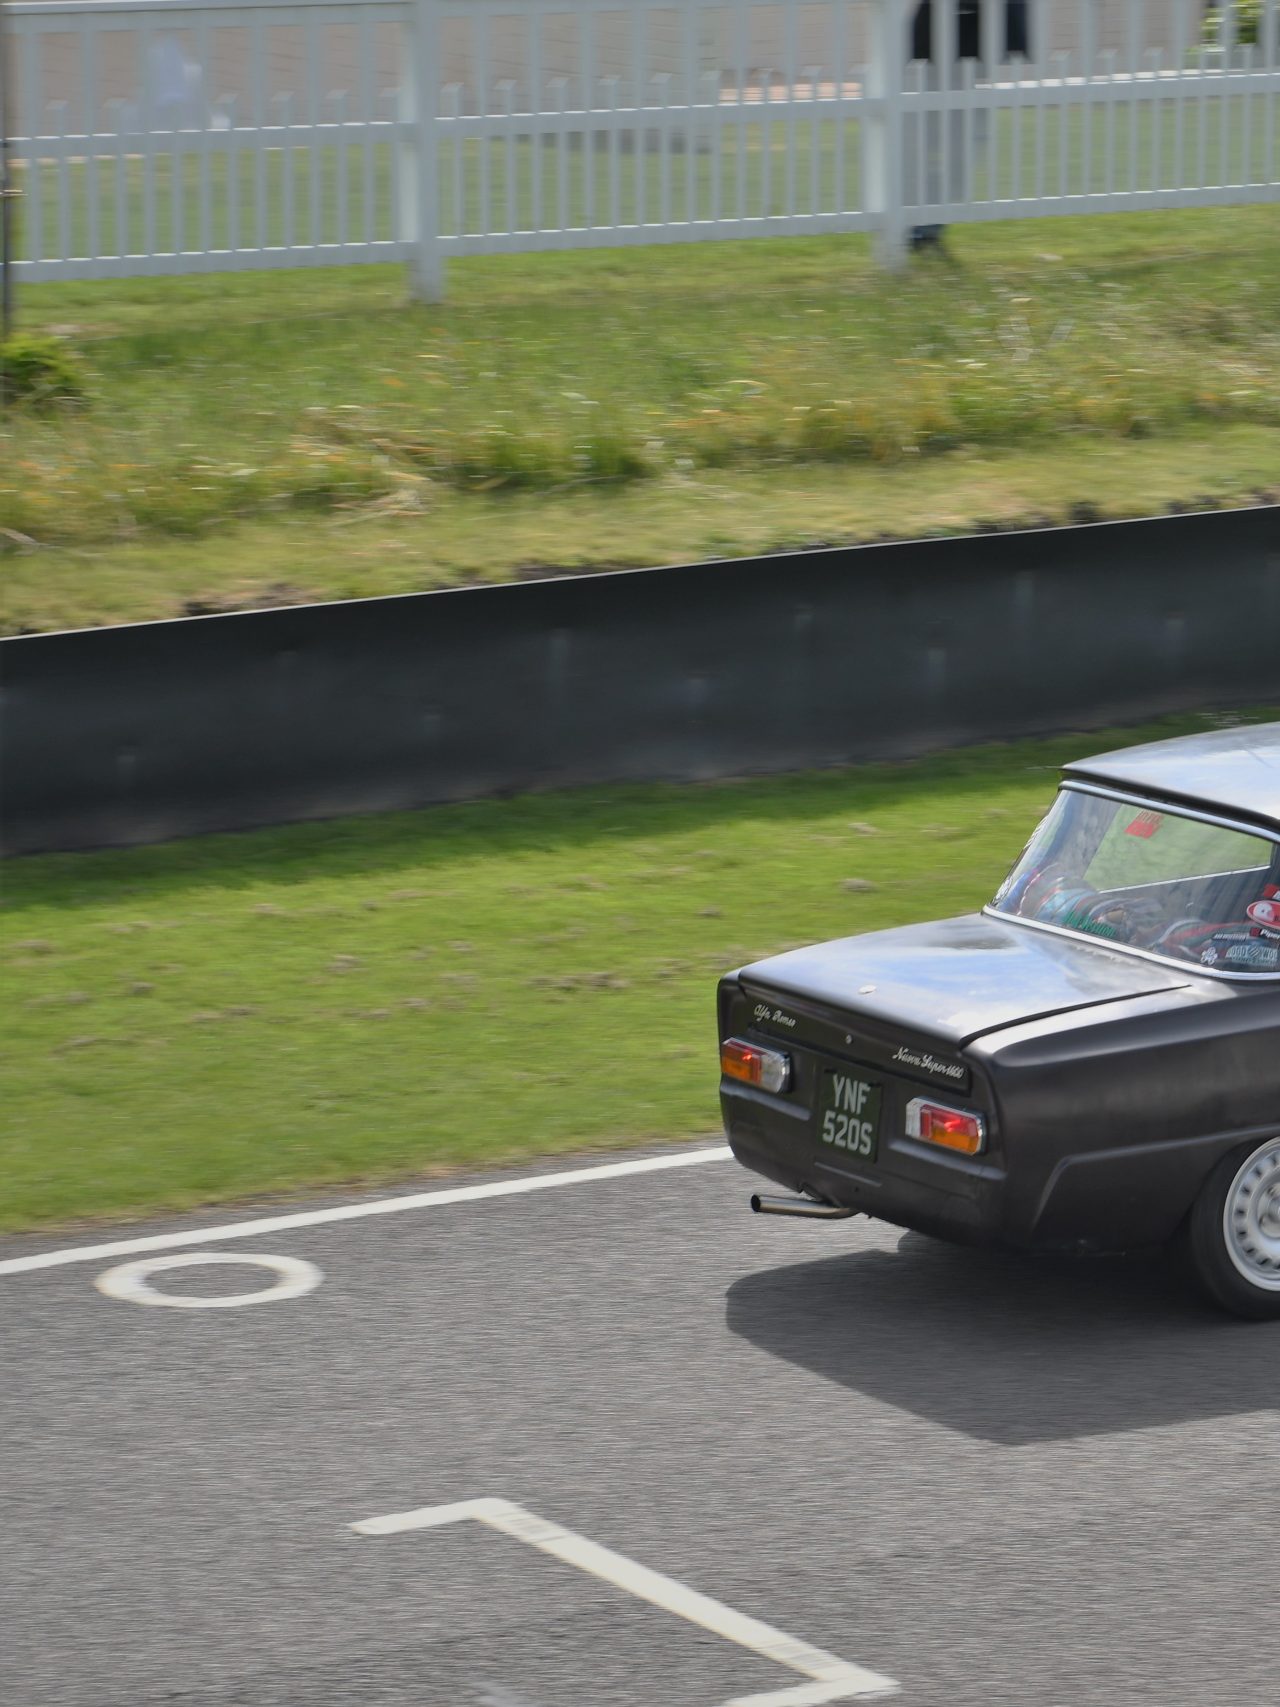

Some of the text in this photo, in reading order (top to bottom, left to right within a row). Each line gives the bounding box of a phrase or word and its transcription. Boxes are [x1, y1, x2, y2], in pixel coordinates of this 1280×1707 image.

[754, 1004, 797, 1029] Alfa Romeo
[832, 1073, 871, 1115] YNF
[822, 1111, 873, 1156] 520S
